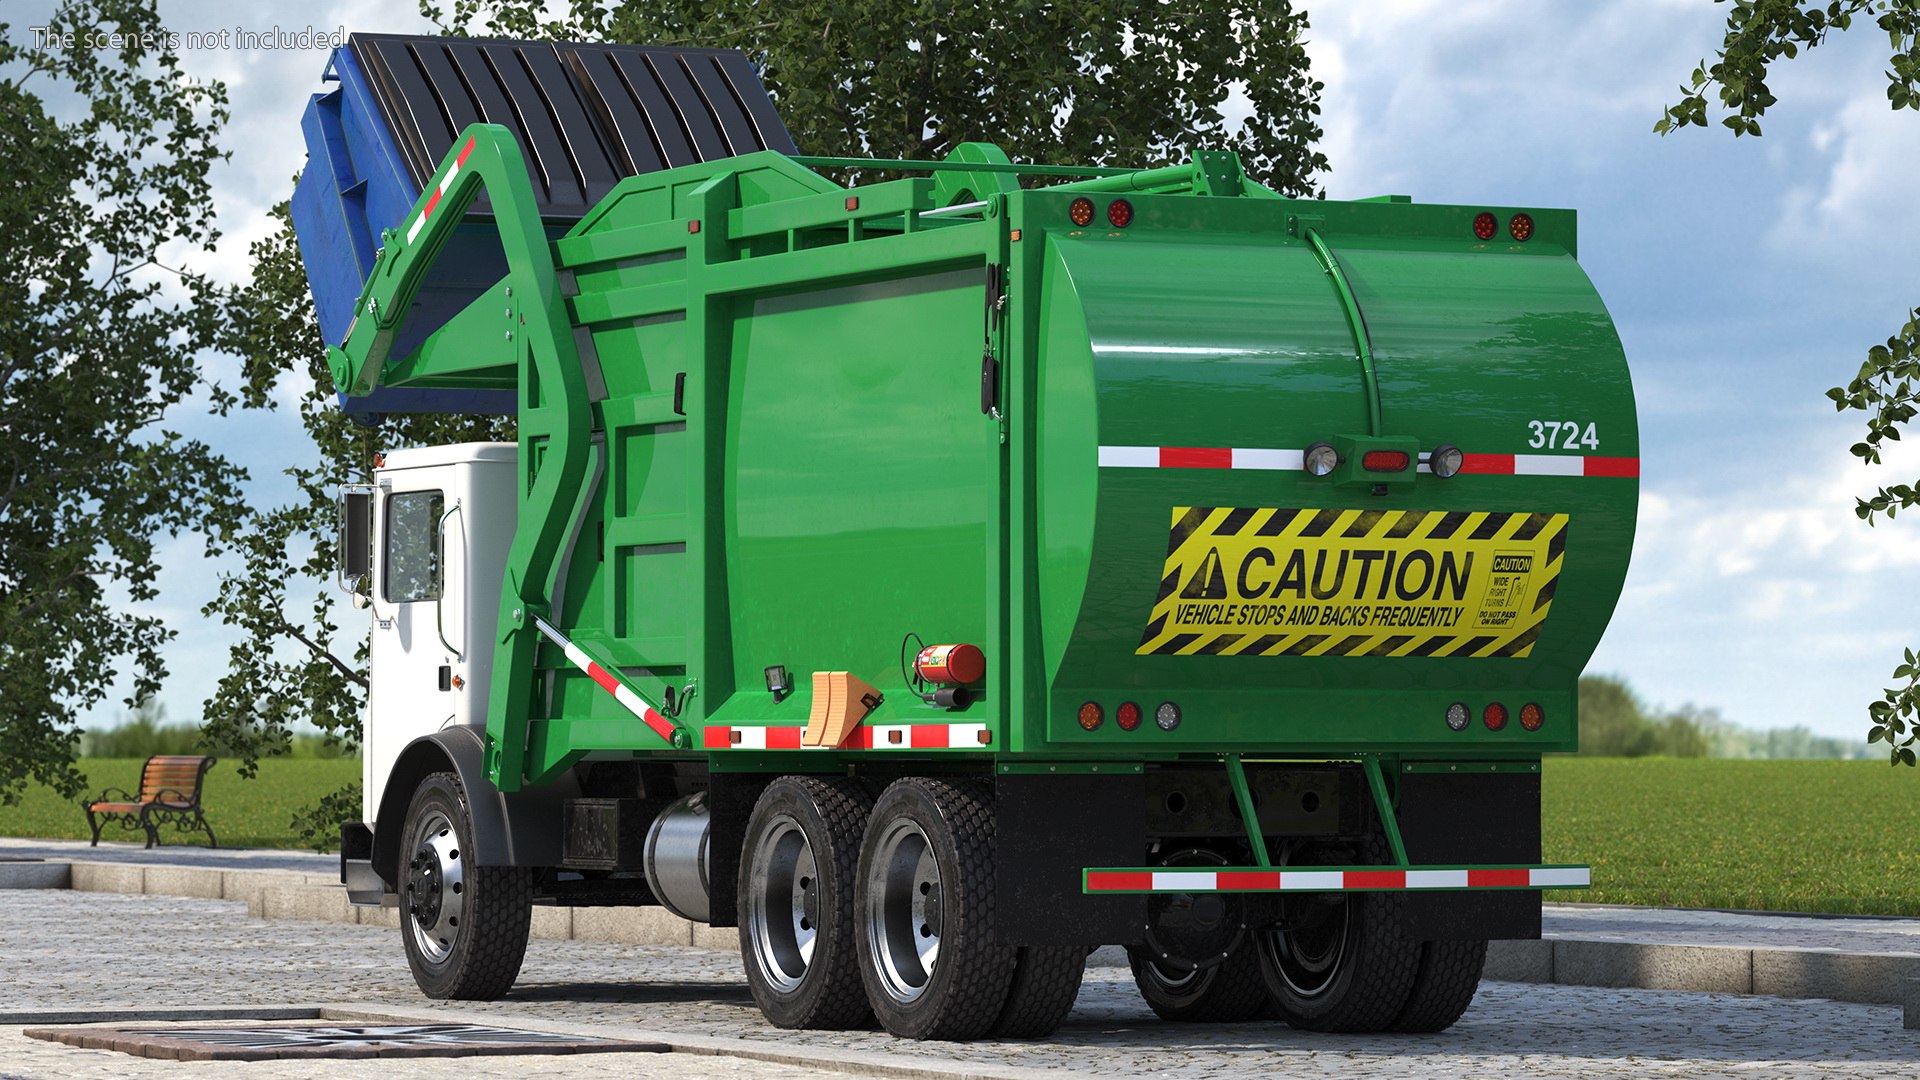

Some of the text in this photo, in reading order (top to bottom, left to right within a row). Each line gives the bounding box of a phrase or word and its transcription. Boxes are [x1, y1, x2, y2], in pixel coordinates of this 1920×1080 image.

[1527, 419, 1600, 451] 3724
[1236, 546, 1475, 601] CAUTION
[1494, 558, 1531, 571] CAUTION
[1494, 577, 1509, 586] WIDE
[1489, 588, 1507, 597] RIGHT
[1175, 603, 1465, 628] VEHICLE STOPS AND BACKS FREQUENTLY
